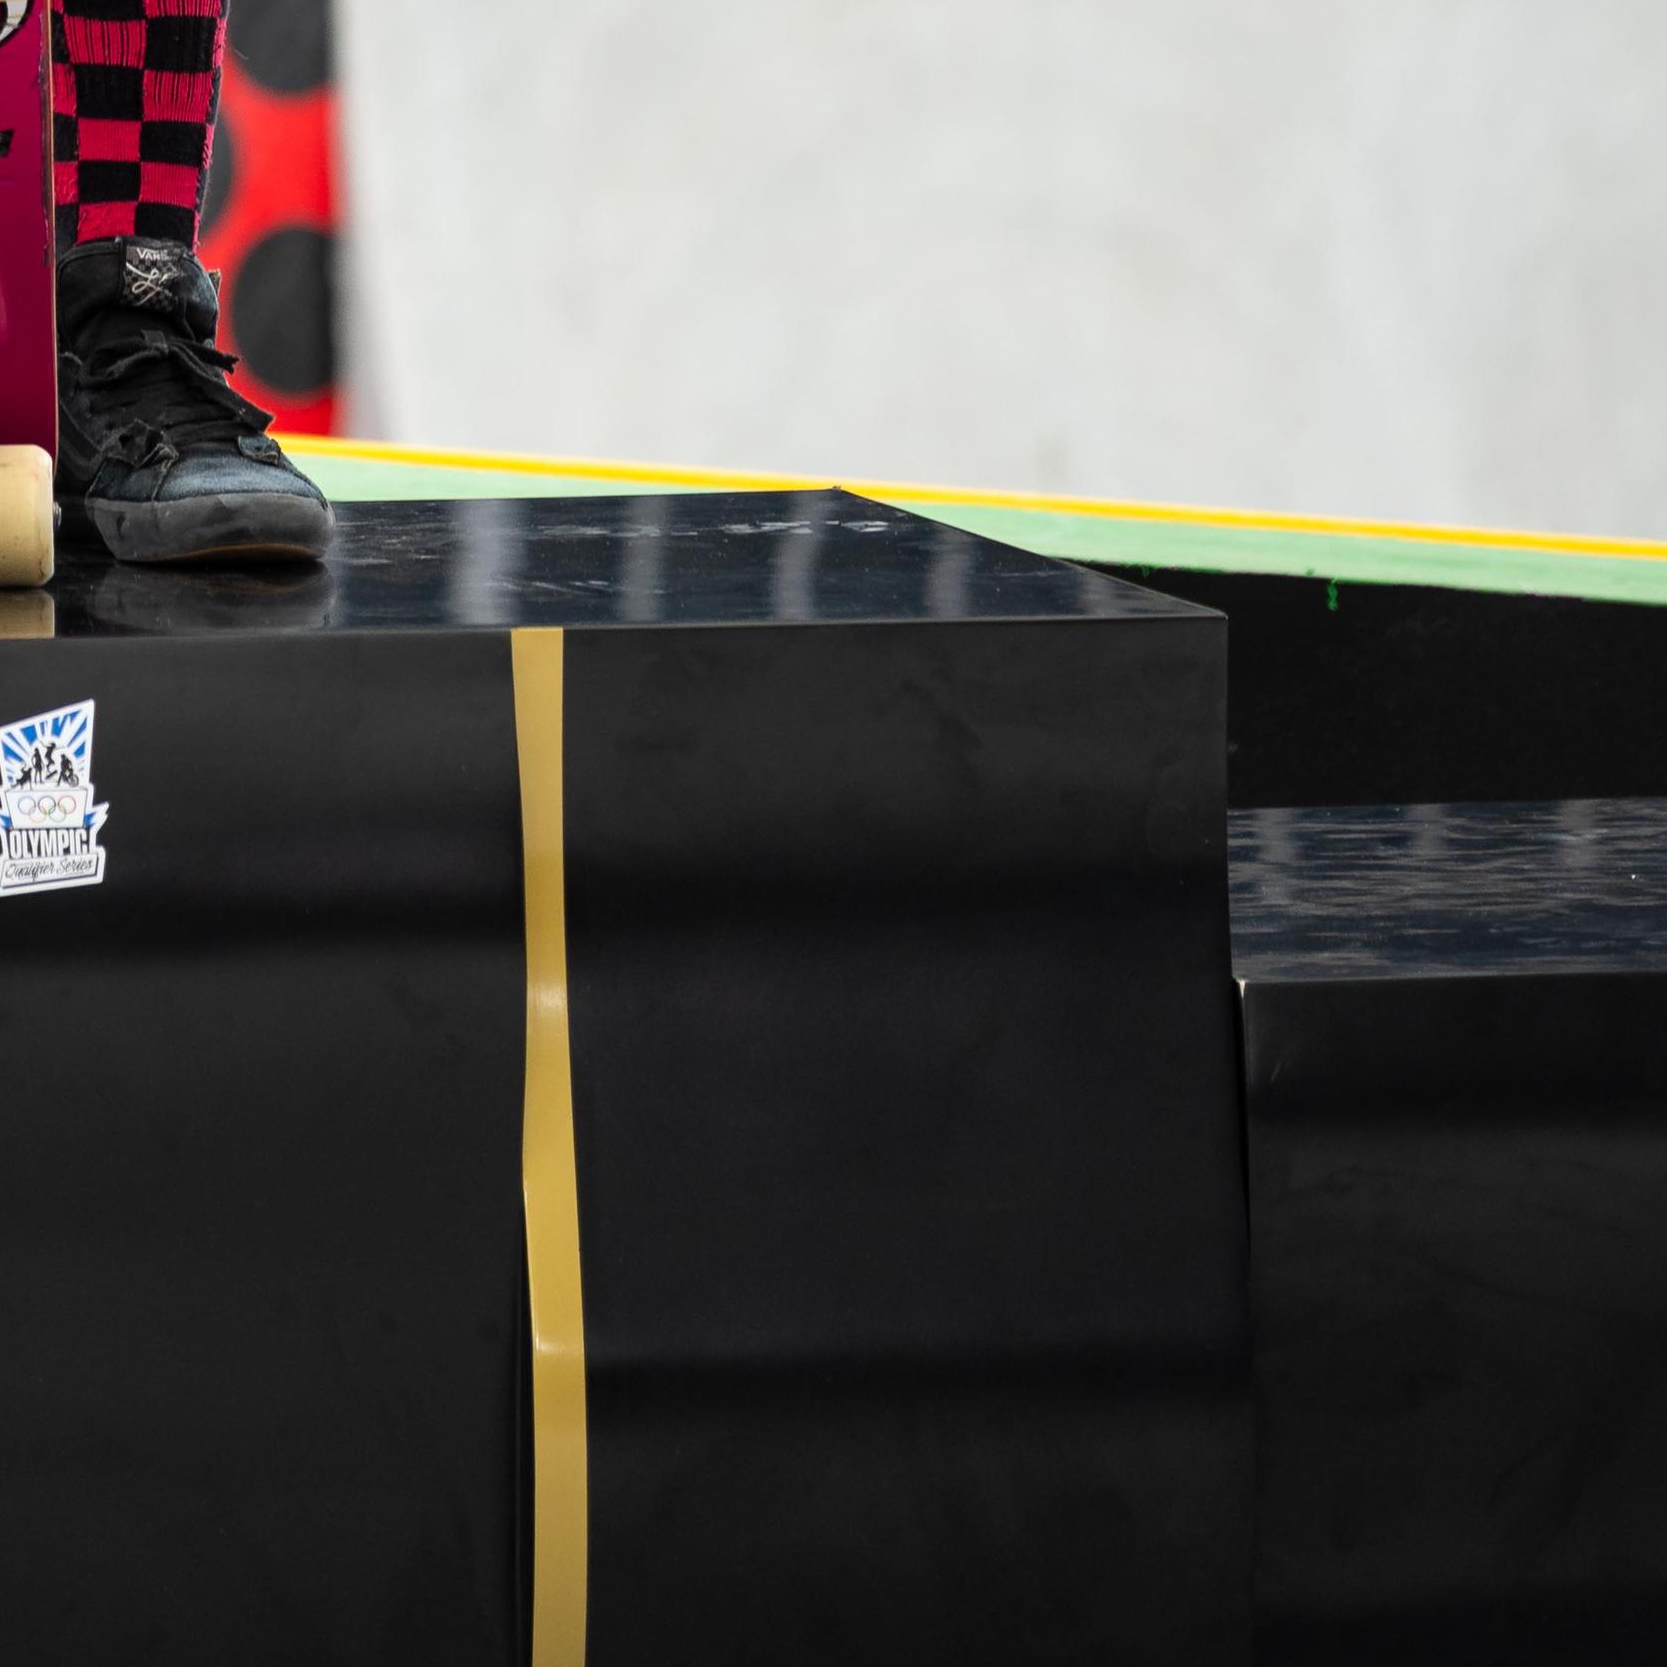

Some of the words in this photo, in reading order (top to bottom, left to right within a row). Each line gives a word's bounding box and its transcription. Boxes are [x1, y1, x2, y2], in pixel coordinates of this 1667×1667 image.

[9, 828, 89, 859] OLYMPIC
[5, 860, 55, 880] Qualifier
[56, 857, 94, 875] Series
